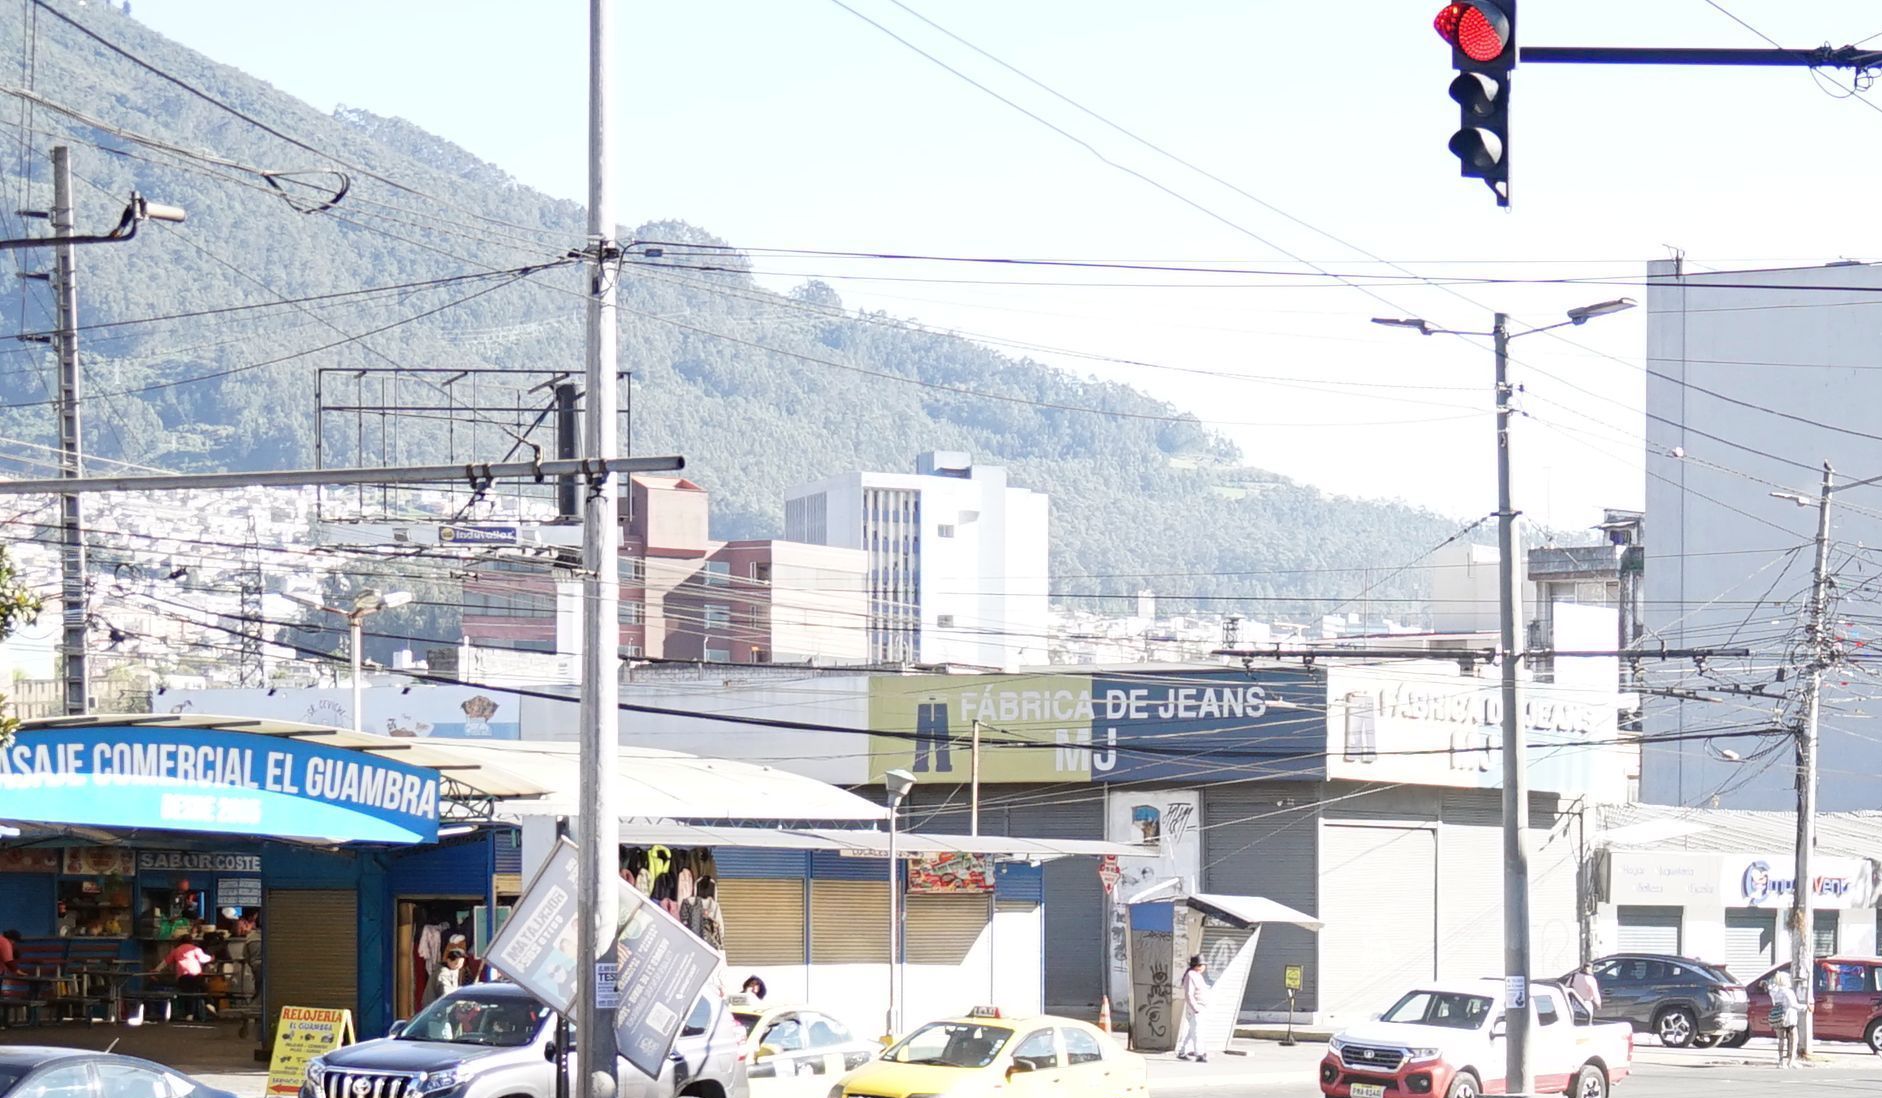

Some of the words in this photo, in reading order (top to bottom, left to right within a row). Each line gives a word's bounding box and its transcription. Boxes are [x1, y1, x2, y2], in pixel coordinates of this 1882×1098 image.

[960, 684, 1095, 721] FÁBRICA
[1106, 689, 1149, 719] DE
[1158, 686, 1267, 719] JEANS
[1055, 727, 1118, 772] MJ
[92, 742, 259, 790] COMERCIAL
[265, 751, 299, 795] EL
[305, 756, 437, 820] GUAMBRA
[215, 855, 262, 871] COSTE
